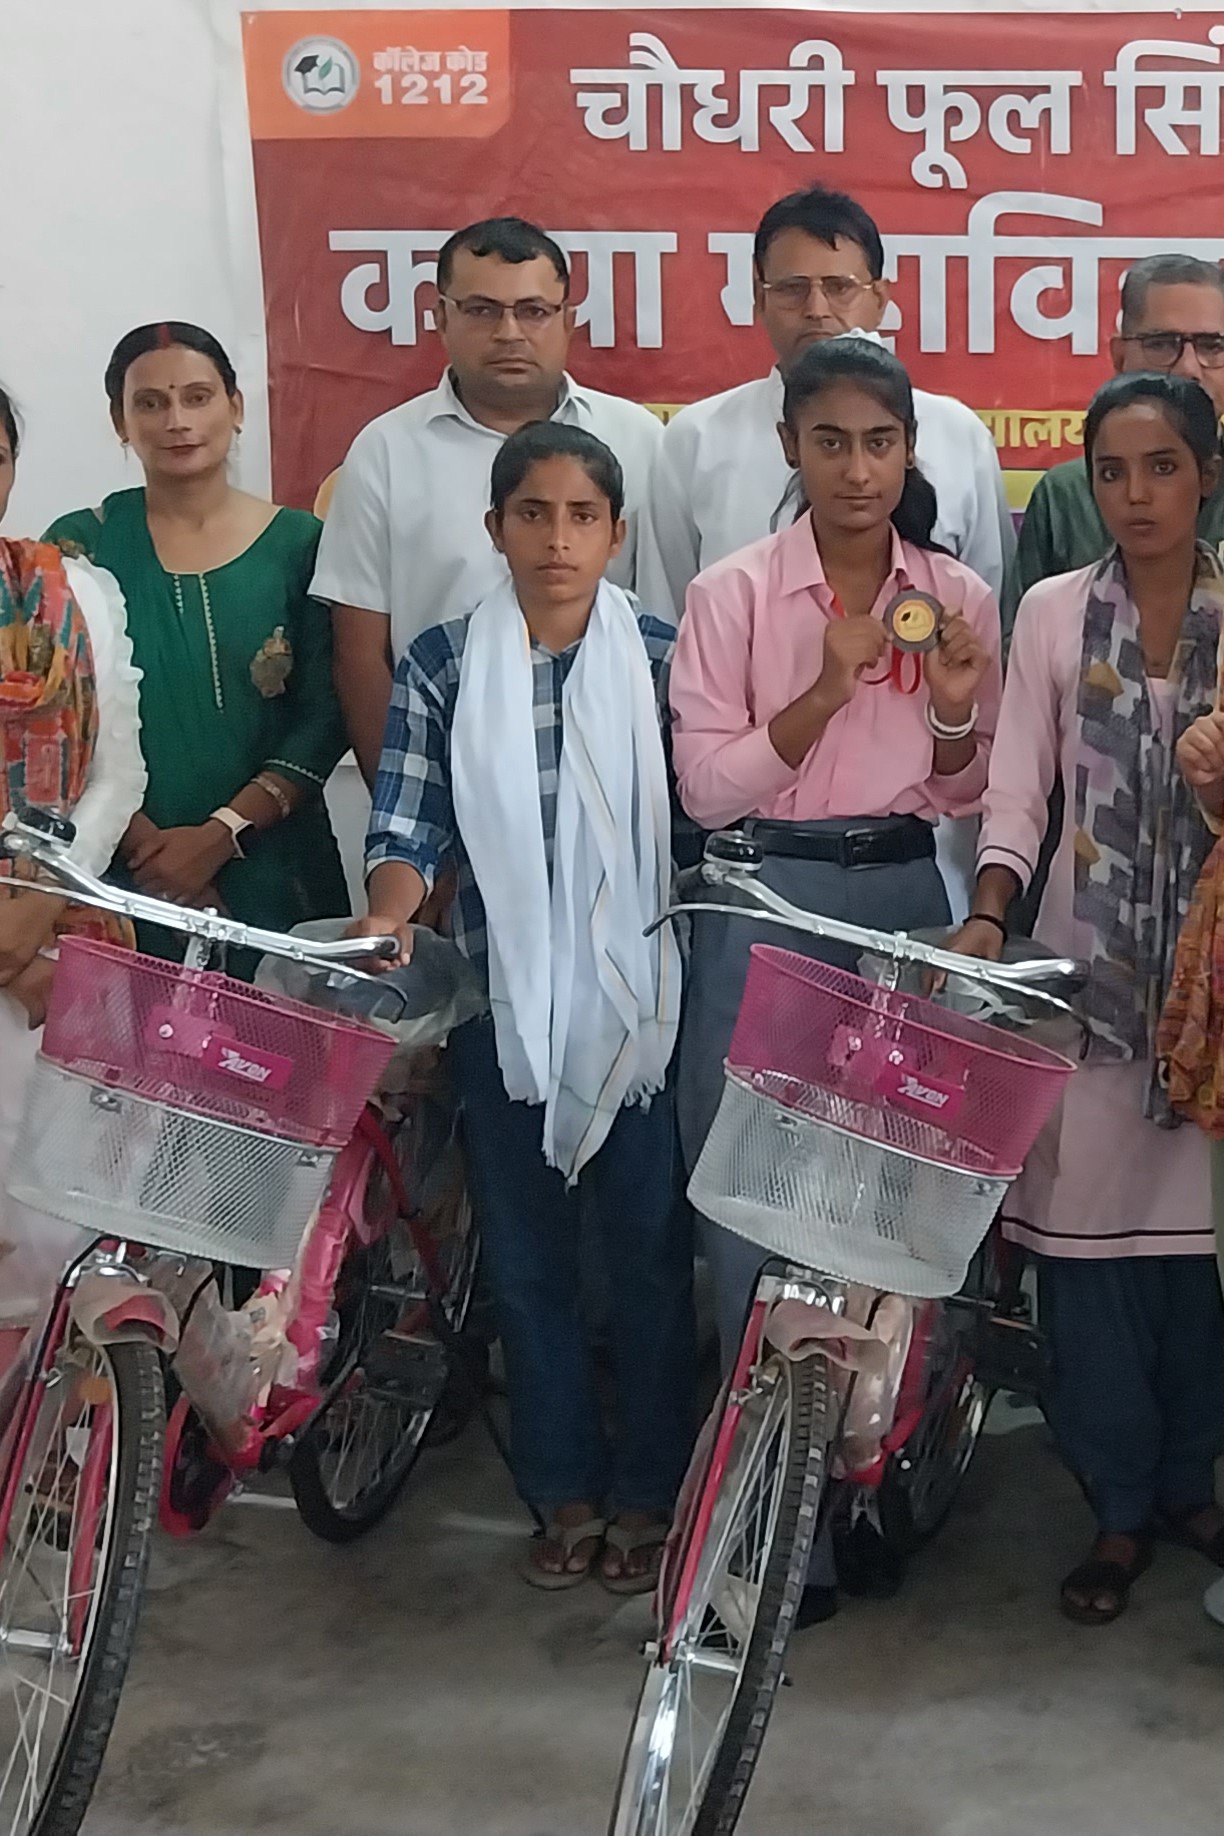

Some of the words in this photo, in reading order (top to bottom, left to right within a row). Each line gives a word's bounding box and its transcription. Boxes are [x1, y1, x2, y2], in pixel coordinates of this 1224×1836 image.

[374, 72, 489, 105] 1212
[444, 44, 489, 73] कोड
[570, 32, 855, 152] चौधरी
[877, 69, 1083, 190] फूल
[328, 229, 678, 349] कया
